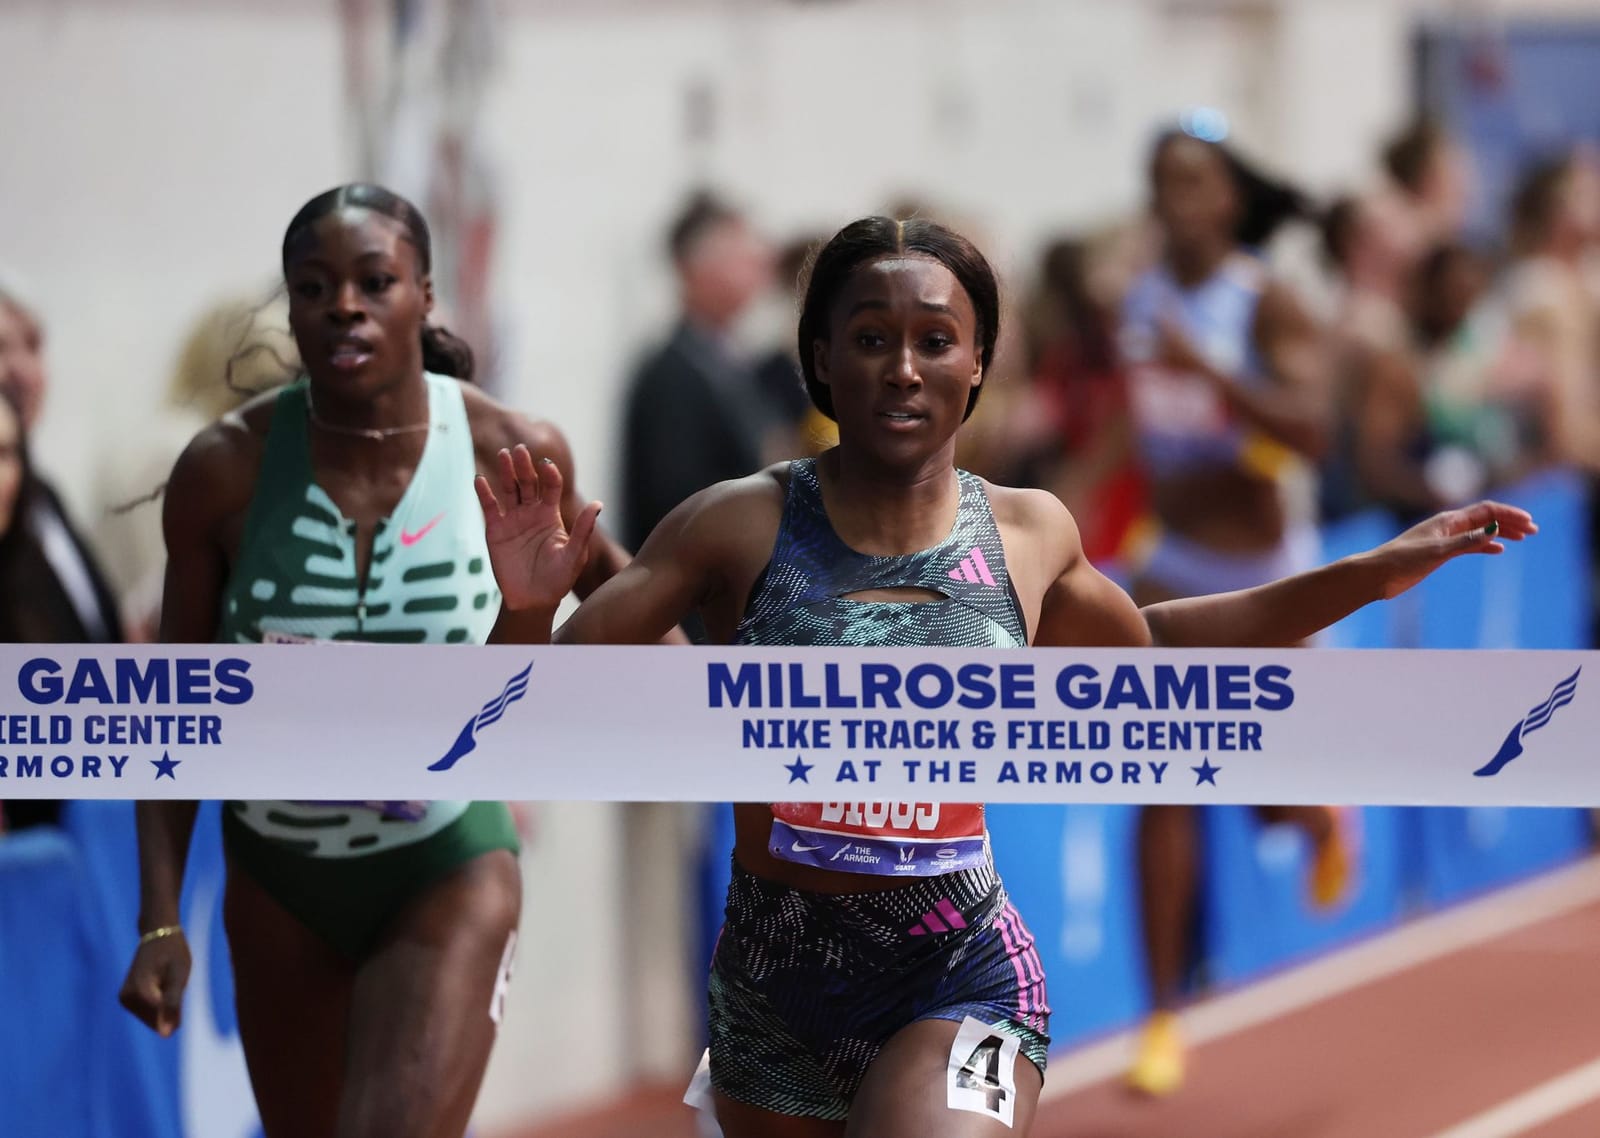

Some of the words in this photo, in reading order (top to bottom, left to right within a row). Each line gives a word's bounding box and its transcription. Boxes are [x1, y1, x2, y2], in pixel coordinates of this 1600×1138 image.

[18, 658, 254, 705] GAMES
[707, 662, 1036, 710] MILLROSE
[1055, 664, 1295, 711] GAMES
[84, 715, 222, 745] CENTER
[742, 719, 831, 749] NIKE
[841, 719, 961, 749] TRACK
[972, 720, 997, 750] &
[1007, 720, 1111, 750] FIELD
[1122, 721, 1262, 751] CENTER
[835, 760, 882, 783] AT
[903, 760, 976, 783] THE
[997, 761, 1169, 784] ARMORY
[843, 853, 881, 864] ARMORY
[855, 846, 872, 855] THE
[956, 1034, 1006, 1113] 4
